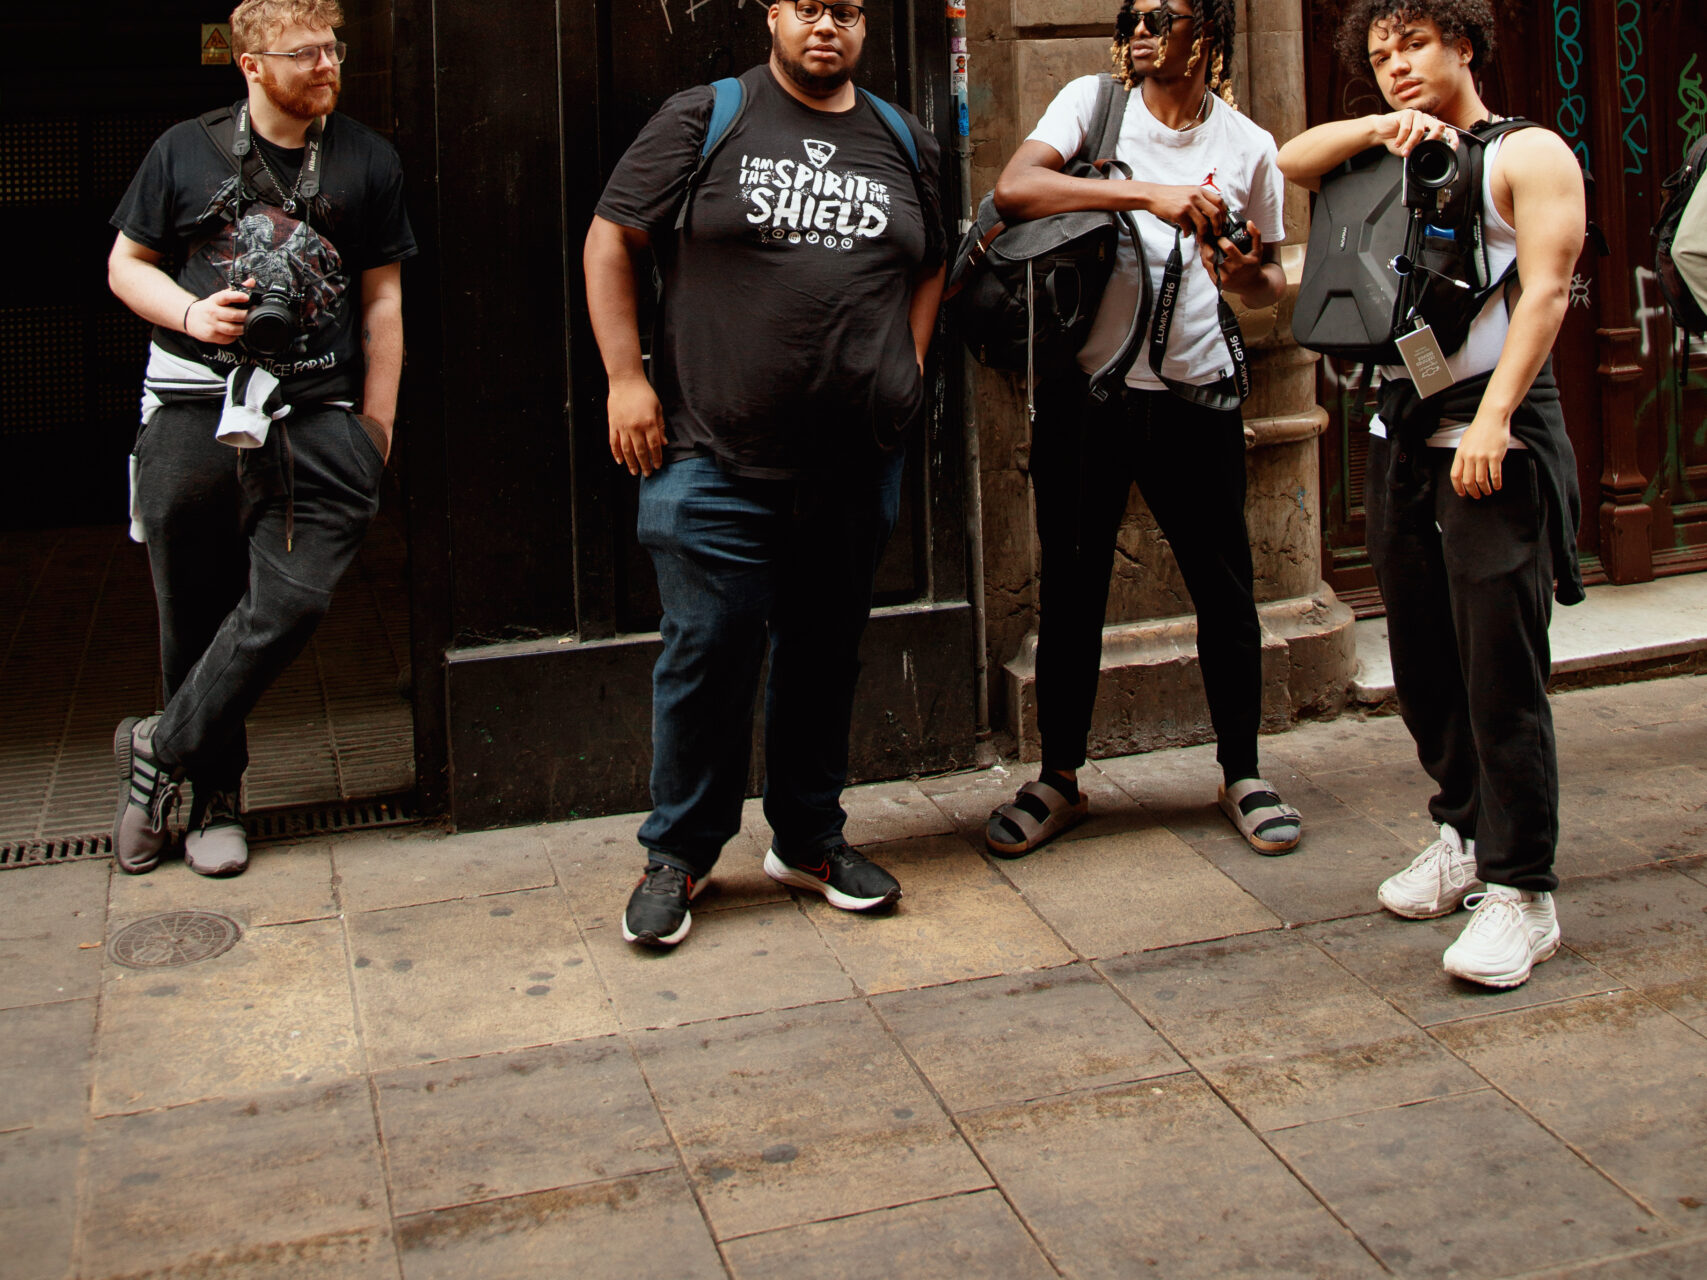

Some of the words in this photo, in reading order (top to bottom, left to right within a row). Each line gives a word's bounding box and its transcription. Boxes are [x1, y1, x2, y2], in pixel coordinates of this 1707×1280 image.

[740, 155, 748, 168] I
[749, 157, 774, 170] AM
[739, 169, 772, 184] THE
[772, 159, 871, 202] SPIRIT
[868, 182, 889, 194] OF
[869, 191, 891, 205] THE
[746, 187, 888, 238] SHIELD
[1162, 282, 1176, 307] GH6
[1155, 309, 1170, 344] LUMIX
[1229, 335, 1245, 362] GH6
